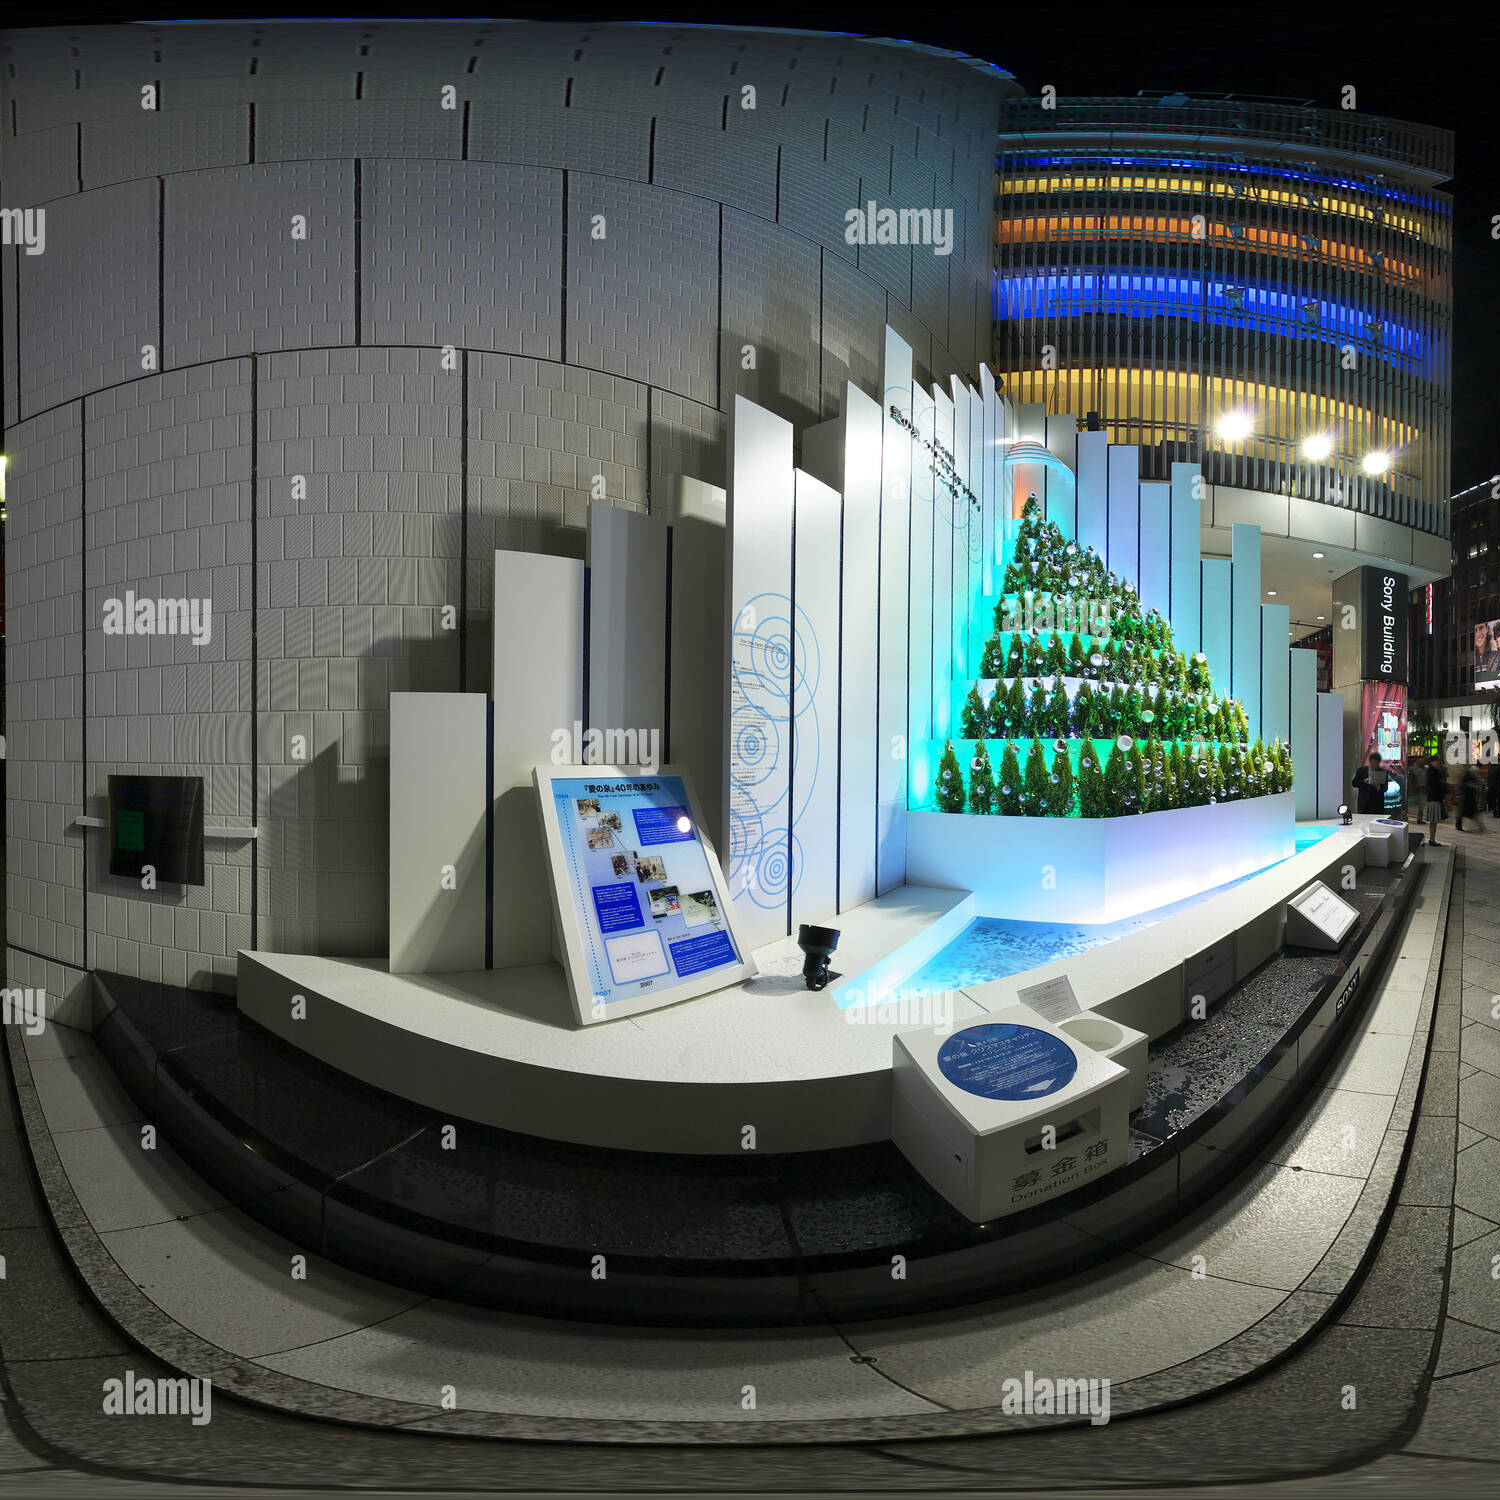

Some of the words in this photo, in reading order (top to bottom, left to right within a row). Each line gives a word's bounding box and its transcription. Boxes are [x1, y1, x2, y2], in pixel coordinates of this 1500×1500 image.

[1381, 576, 1395, 612] Sony
[1381, 615, 1395, 674] Building
[639, 980, 653, 988] 2007
[1337, 969, 1360, 1011] SONY
[1011, 1138, 1109, 1192] 募金箱
[1011, 1172, 1080, 1204] Donation
[1084, 1158, 1109, 1175] Box
